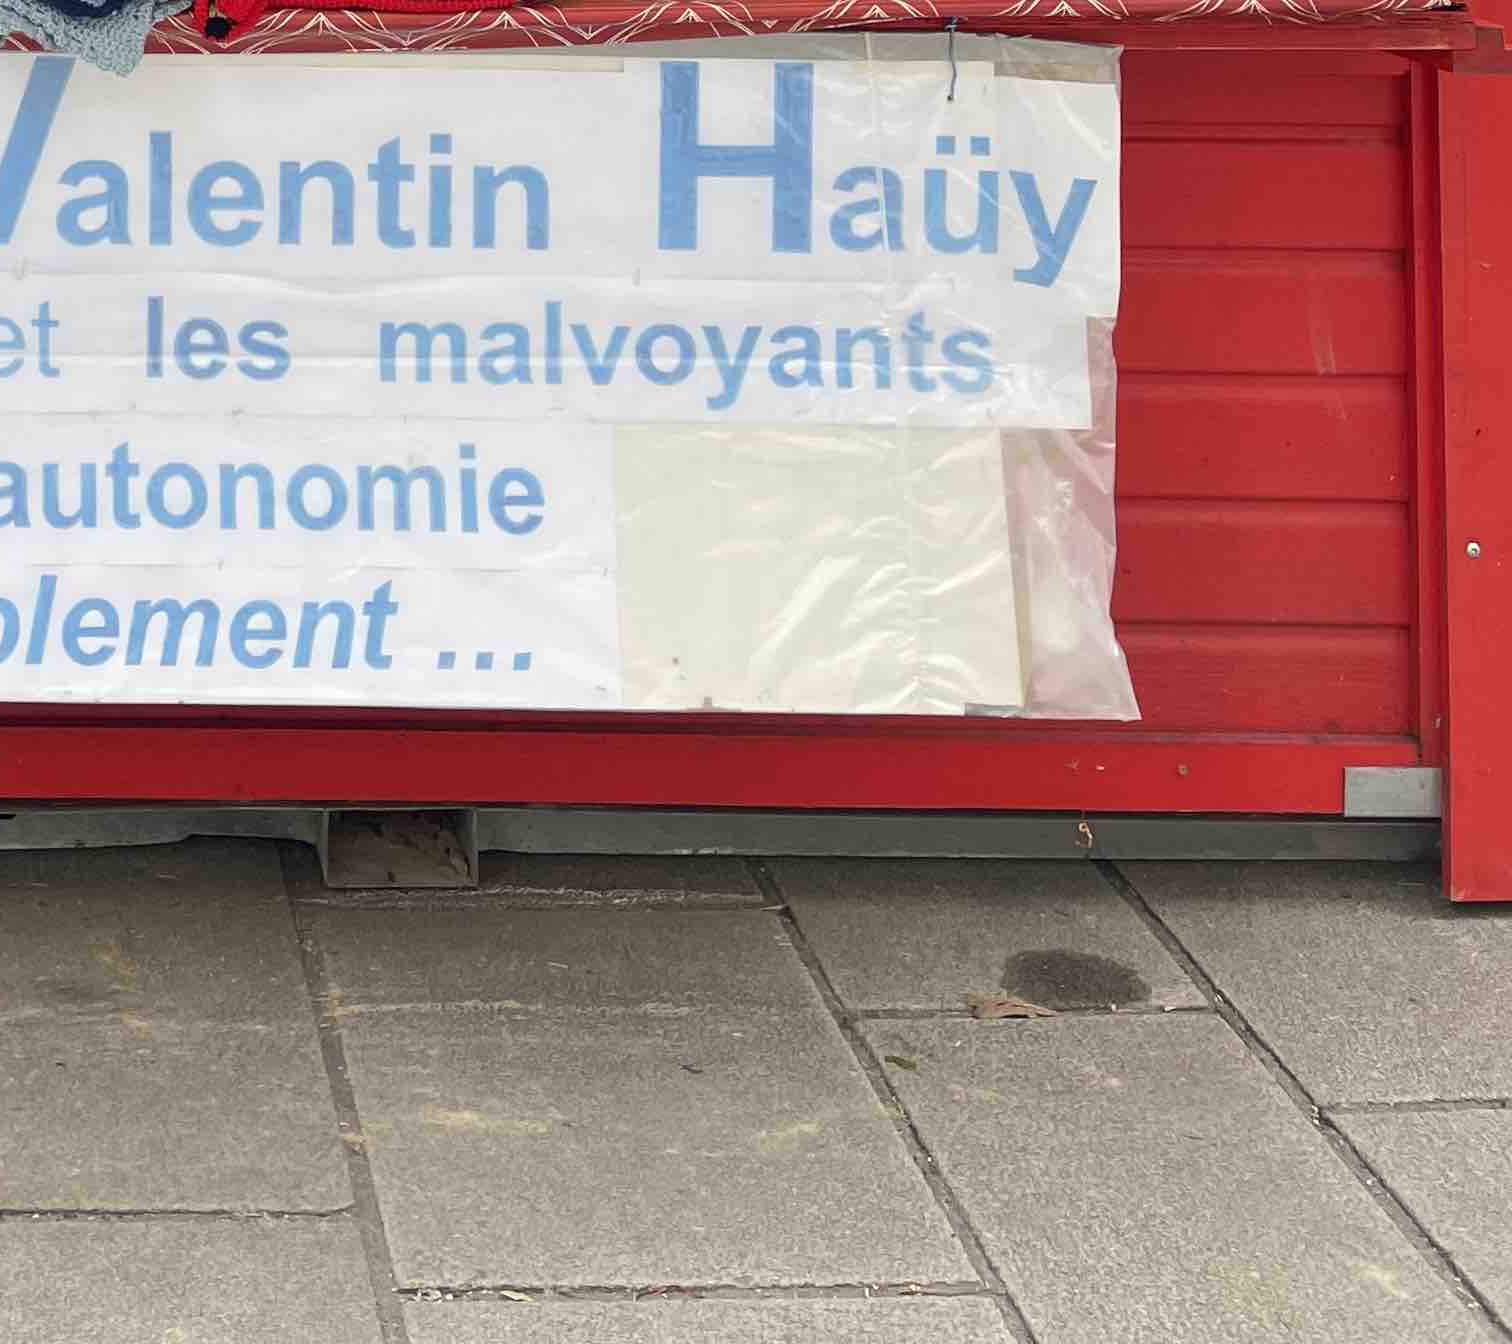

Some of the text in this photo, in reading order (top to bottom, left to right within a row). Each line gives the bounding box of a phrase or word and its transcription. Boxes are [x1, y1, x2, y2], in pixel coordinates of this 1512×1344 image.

[656, 62, 1097, 288] Haüy
[147, 298, 291, 382] les
[377, 301, 994, 409] malvoyants
